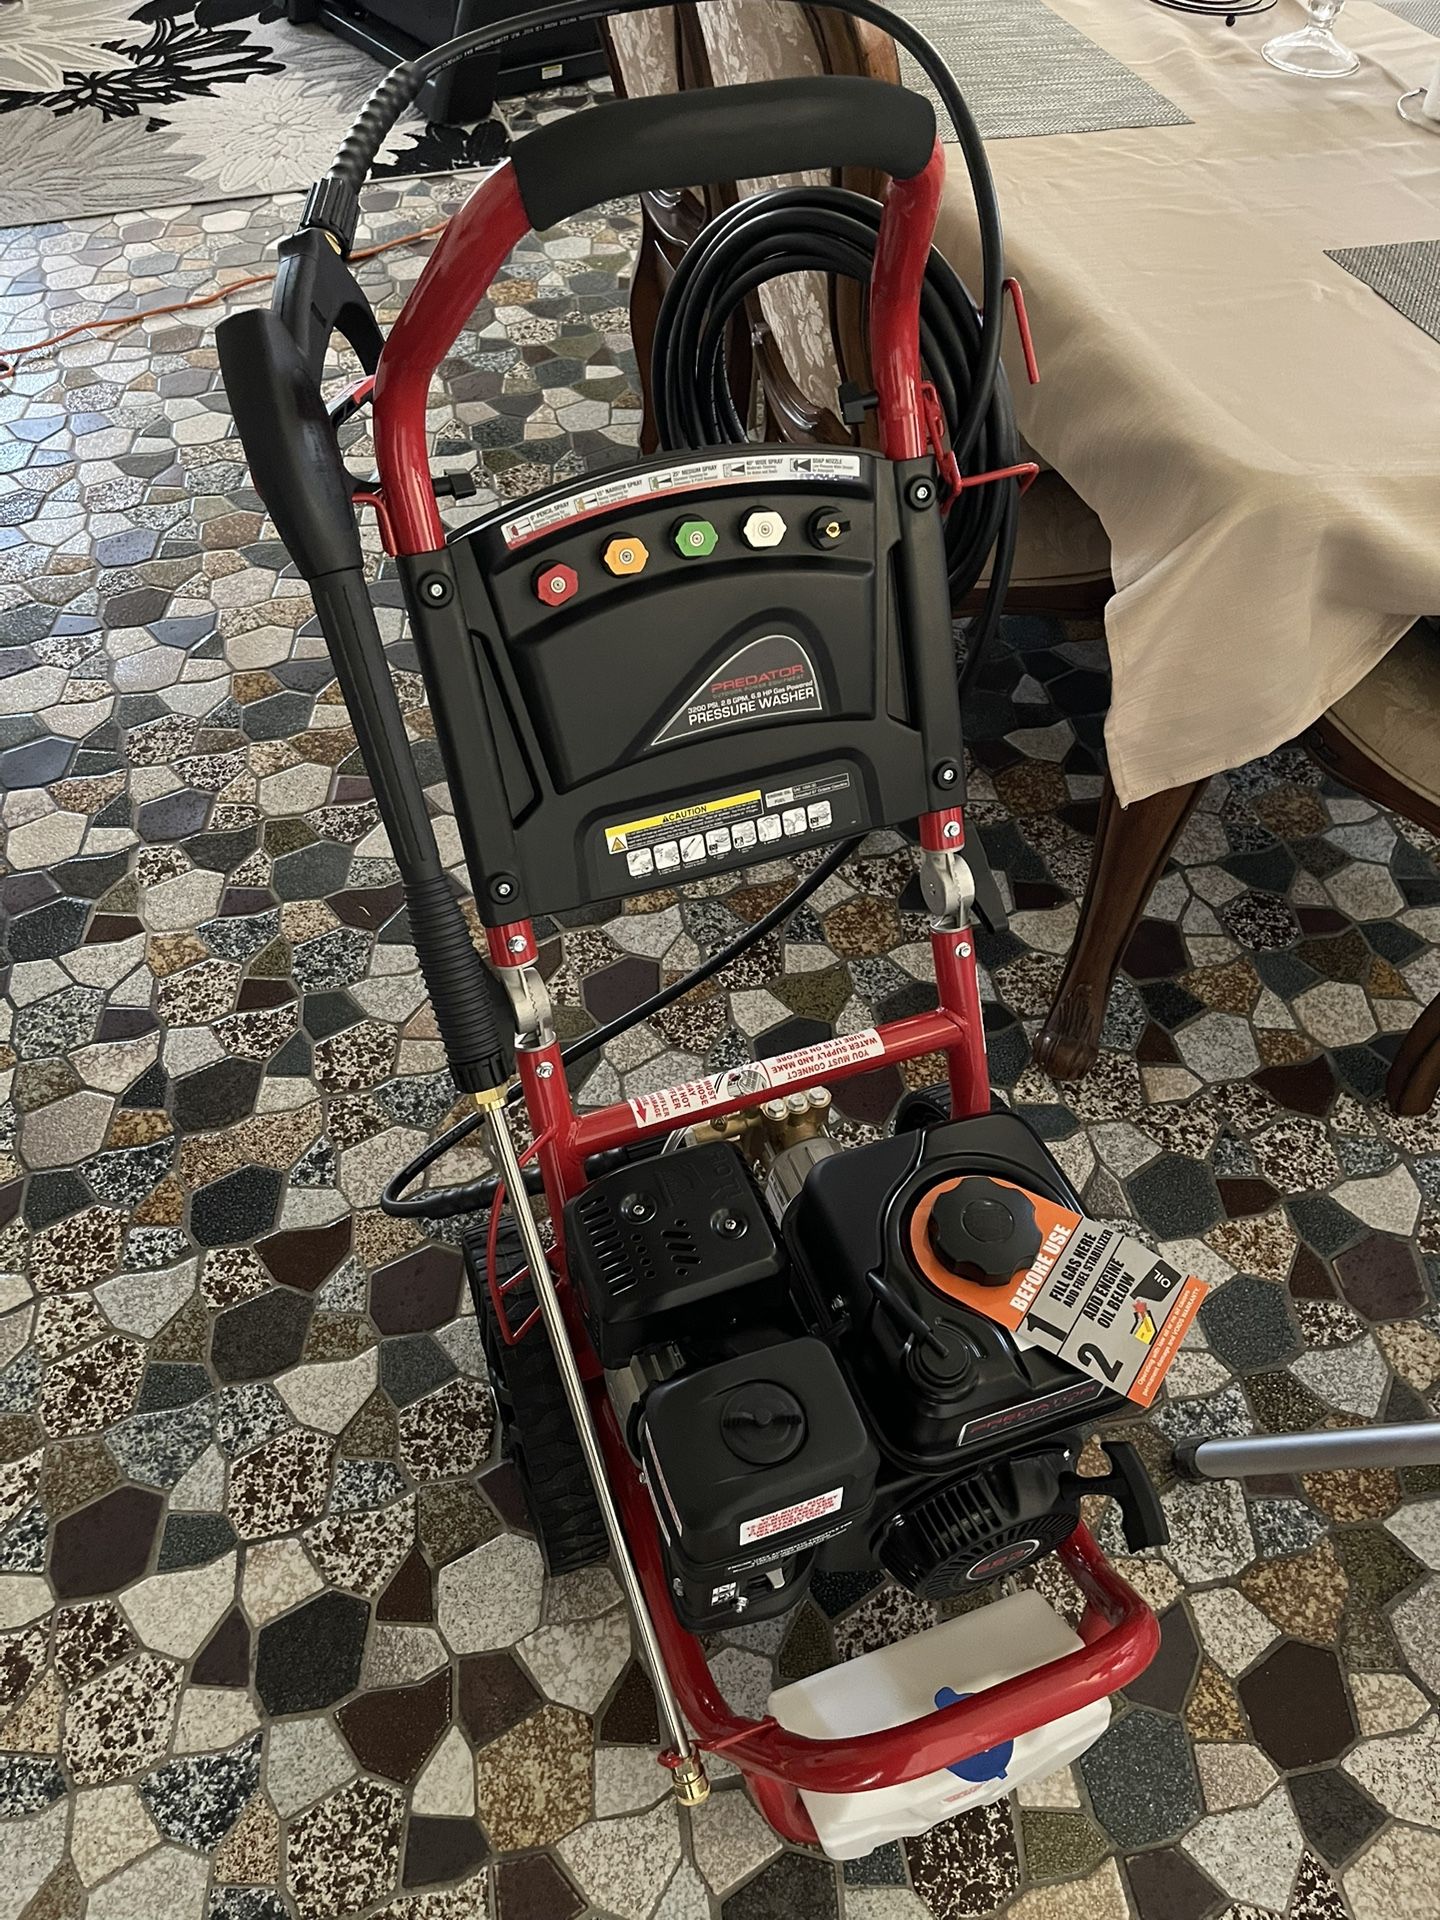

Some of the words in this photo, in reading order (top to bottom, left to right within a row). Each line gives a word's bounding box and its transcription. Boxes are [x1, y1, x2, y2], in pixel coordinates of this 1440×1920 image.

[627, 479, 642, 490] SPRAY
[554, 501, 570, 510] SPRAY
[711, 664, 805, 693] PREDATOR
[688, 703, 707, 714] 3200
[762, 689, 772, 697] HP
[773, 687, 786, 695] Gas
[786, 680, 813, 691] Powered
[688, 702, 756, 726] PRESSURE
[758, 687, 815, 709] WASHER
[668, 805, 707, 821] CAUTION
[817, 1045, 847, 1059] SUPPLY
[849, 1037, 877, 1050] WATER
[798, 1056, 814, 1065] AND
[828, 1055, 850, 1067] MUST
[853, 1050, 869, 1059] YOU
[771, 1061, 796, 1073] MAKE
[787, 1062, 825, 1080] CONNECT
[697, 1084, 709, 1105] HOSE
[703, 1080, 716, 1101] MUST
[1009, 1253, 1054, 1313] BEFORE
[1043, 1224, 1071, 1255] USE
[1049, 1280, 1070, 1302] FILL
[1061, 1258, 1082, 1280] GAS
[1073, 1232, 1096, 1260] HERE
[1063, 1289, 1079, 1308] ADD
[1073, 1272, 1090, 1290] FUEL
[1083, 1229, 1114, 1272] STABILIZER
[1153, 1268, 1171, 1288] OIL
[1083, 1295, 1104, 1321] ADD
[1096, 1258, 1124, 1297] ENGINE
[1097, 1309, 1116, 1328] OIL
[1107, 1272, 1135, 1311] BELOW
[1027, 1313, 1068, 1341] 1
[1168, 1335, 1176, 1346] and
[1172, 1318, 1184, 1335] VOIDS
[1077, 1343, 1124, 1382] 2
[1137, 1359, 1155, 1385] Operating
